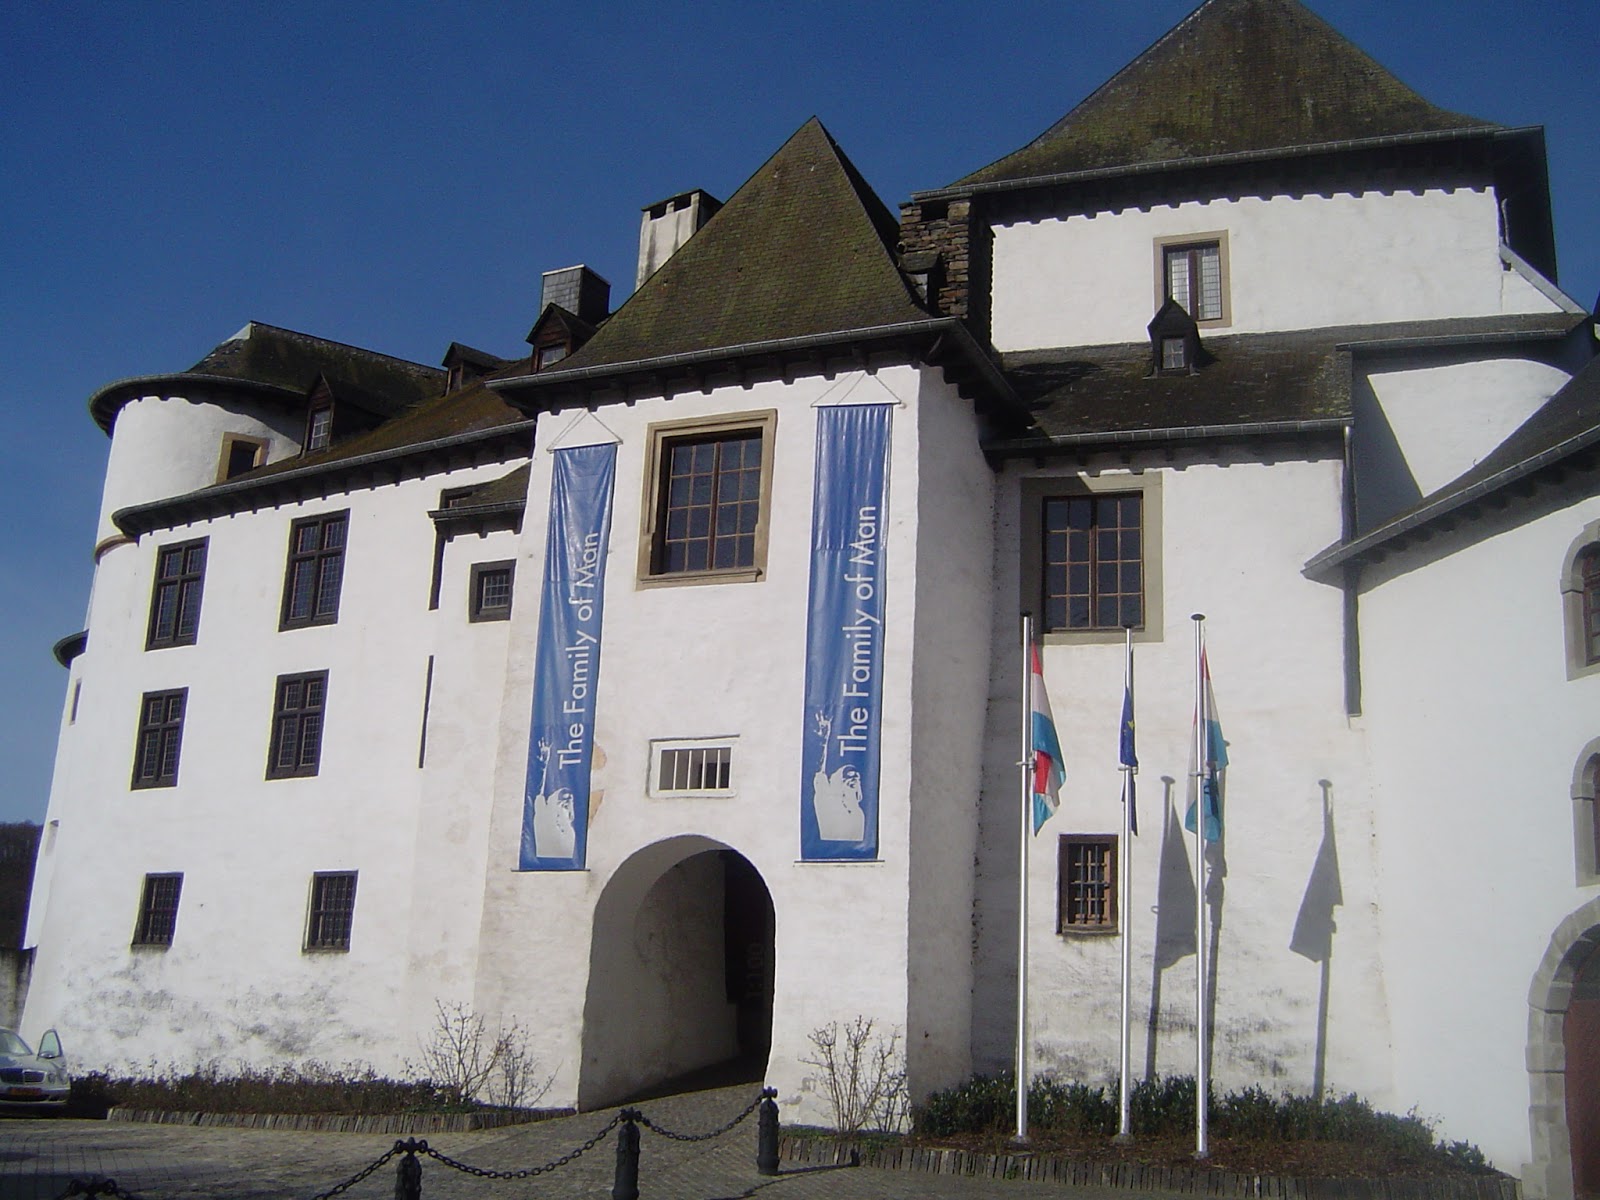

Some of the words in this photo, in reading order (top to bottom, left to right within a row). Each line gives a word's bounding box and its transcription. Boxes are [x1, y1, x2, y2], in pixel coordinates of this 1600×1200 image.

[576, 532, 599, 587] Man
[850, 505, 876, 565] Man
[568, 597, 593, 622] of
[844, 573, 874, 600] of
[563, 630, 597, 713] Family
[842, 613, 880, 697] Family
[557, 722, 583, 770] The
[837, 709, 868, 756] The
